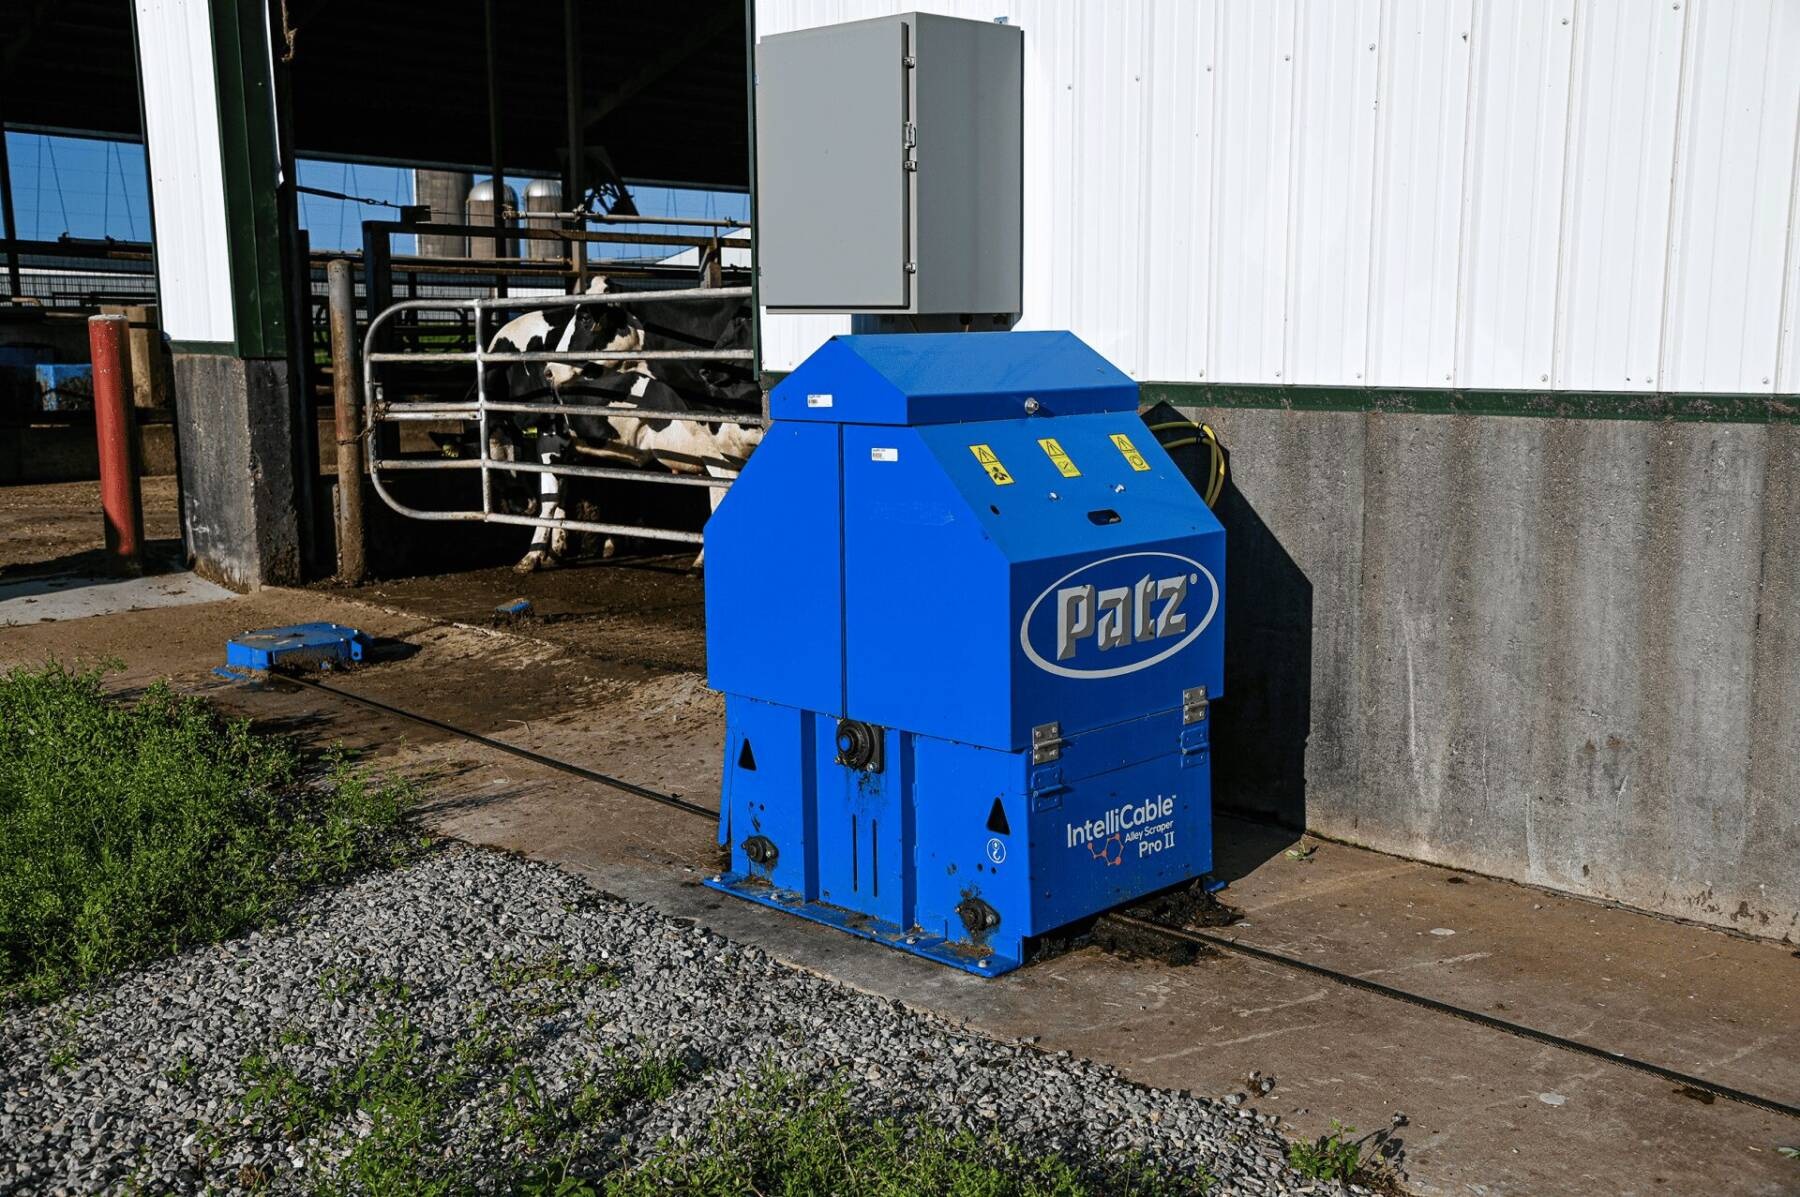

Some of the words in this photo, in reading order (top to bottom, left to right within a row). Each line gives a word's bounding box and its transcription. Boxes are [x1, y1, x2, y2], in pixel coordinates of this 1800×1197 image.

[1124, 831, 1143, 843] Alley
[1144, 820, 1174, 836] Scraper
[1139, 840, 1162, 858] Pro
[1164, 831, 1175, 849] II
